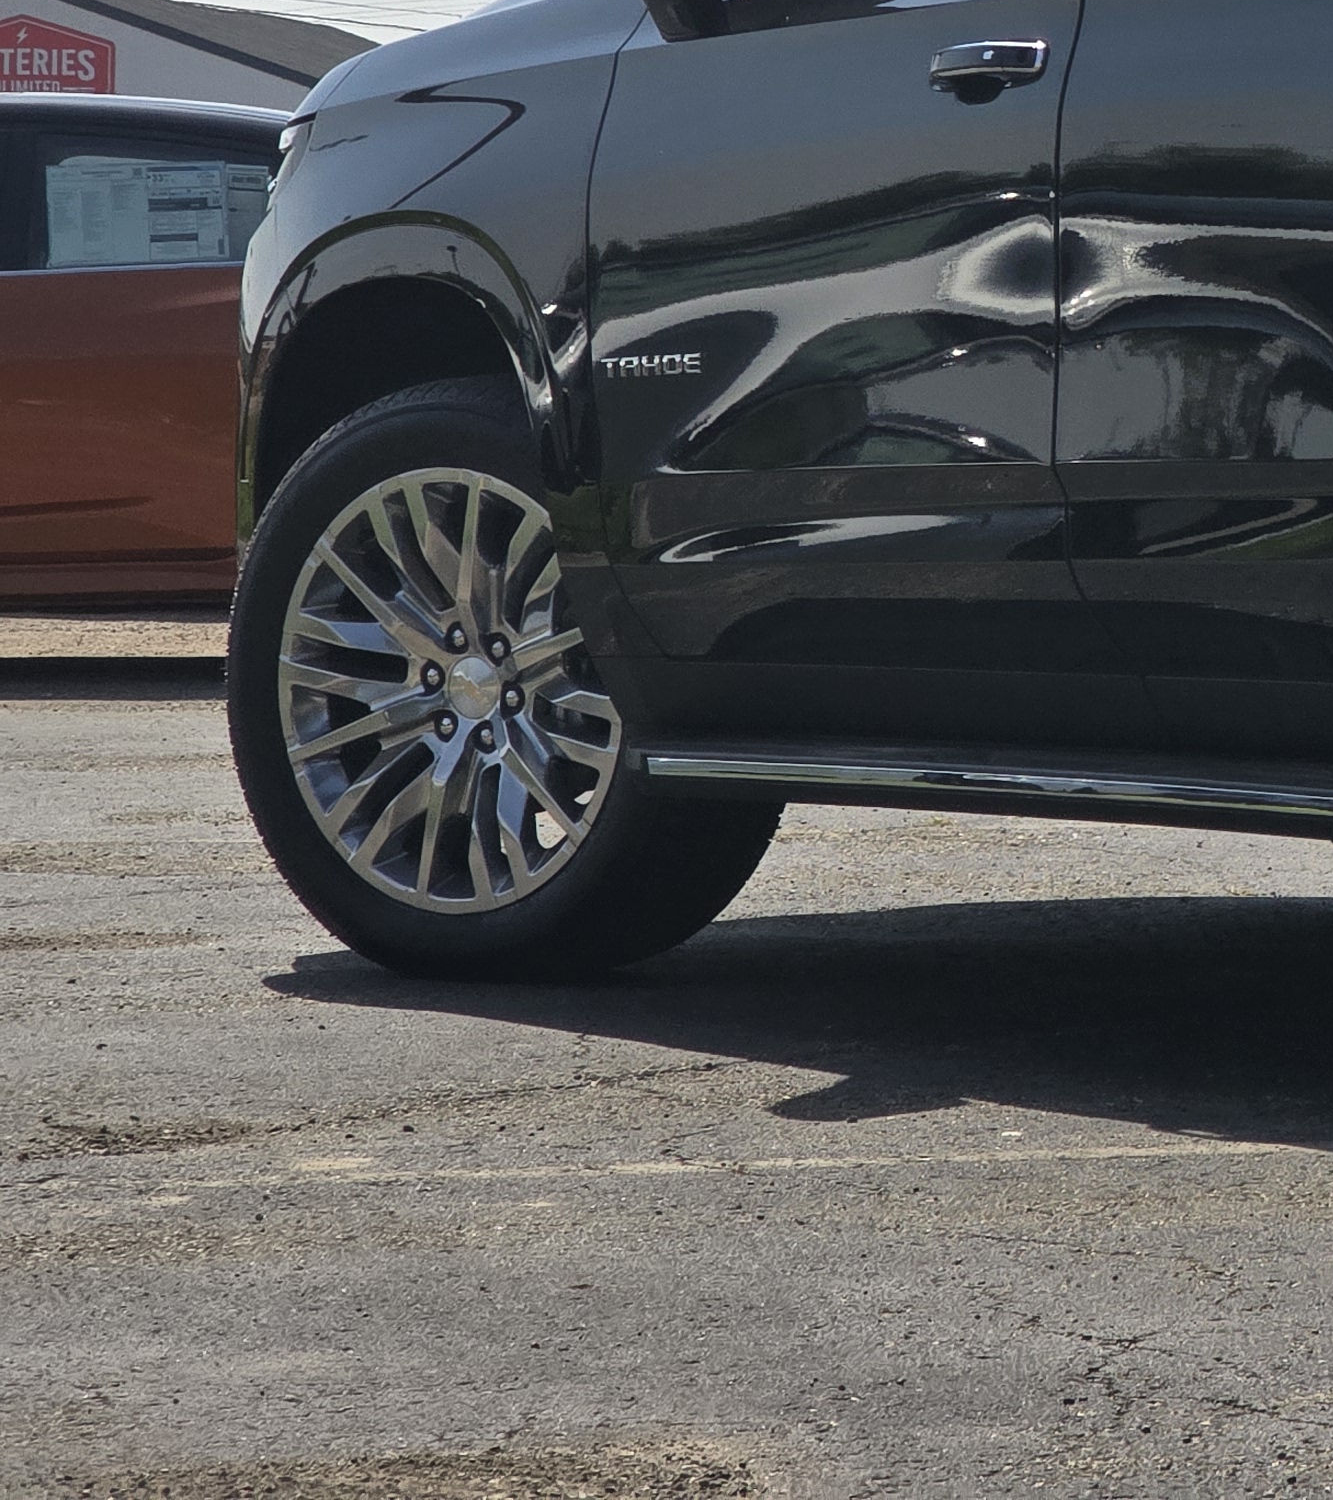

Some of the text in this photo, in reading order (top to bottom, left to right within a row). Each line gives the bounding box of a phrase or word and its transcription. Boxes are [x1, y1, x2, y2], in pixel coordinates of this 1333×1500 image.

[0, 47, 96, 81] TERIES
[0, 79, 60, 92] LIMITED
[601, 352, 702, 378] TAHOE
